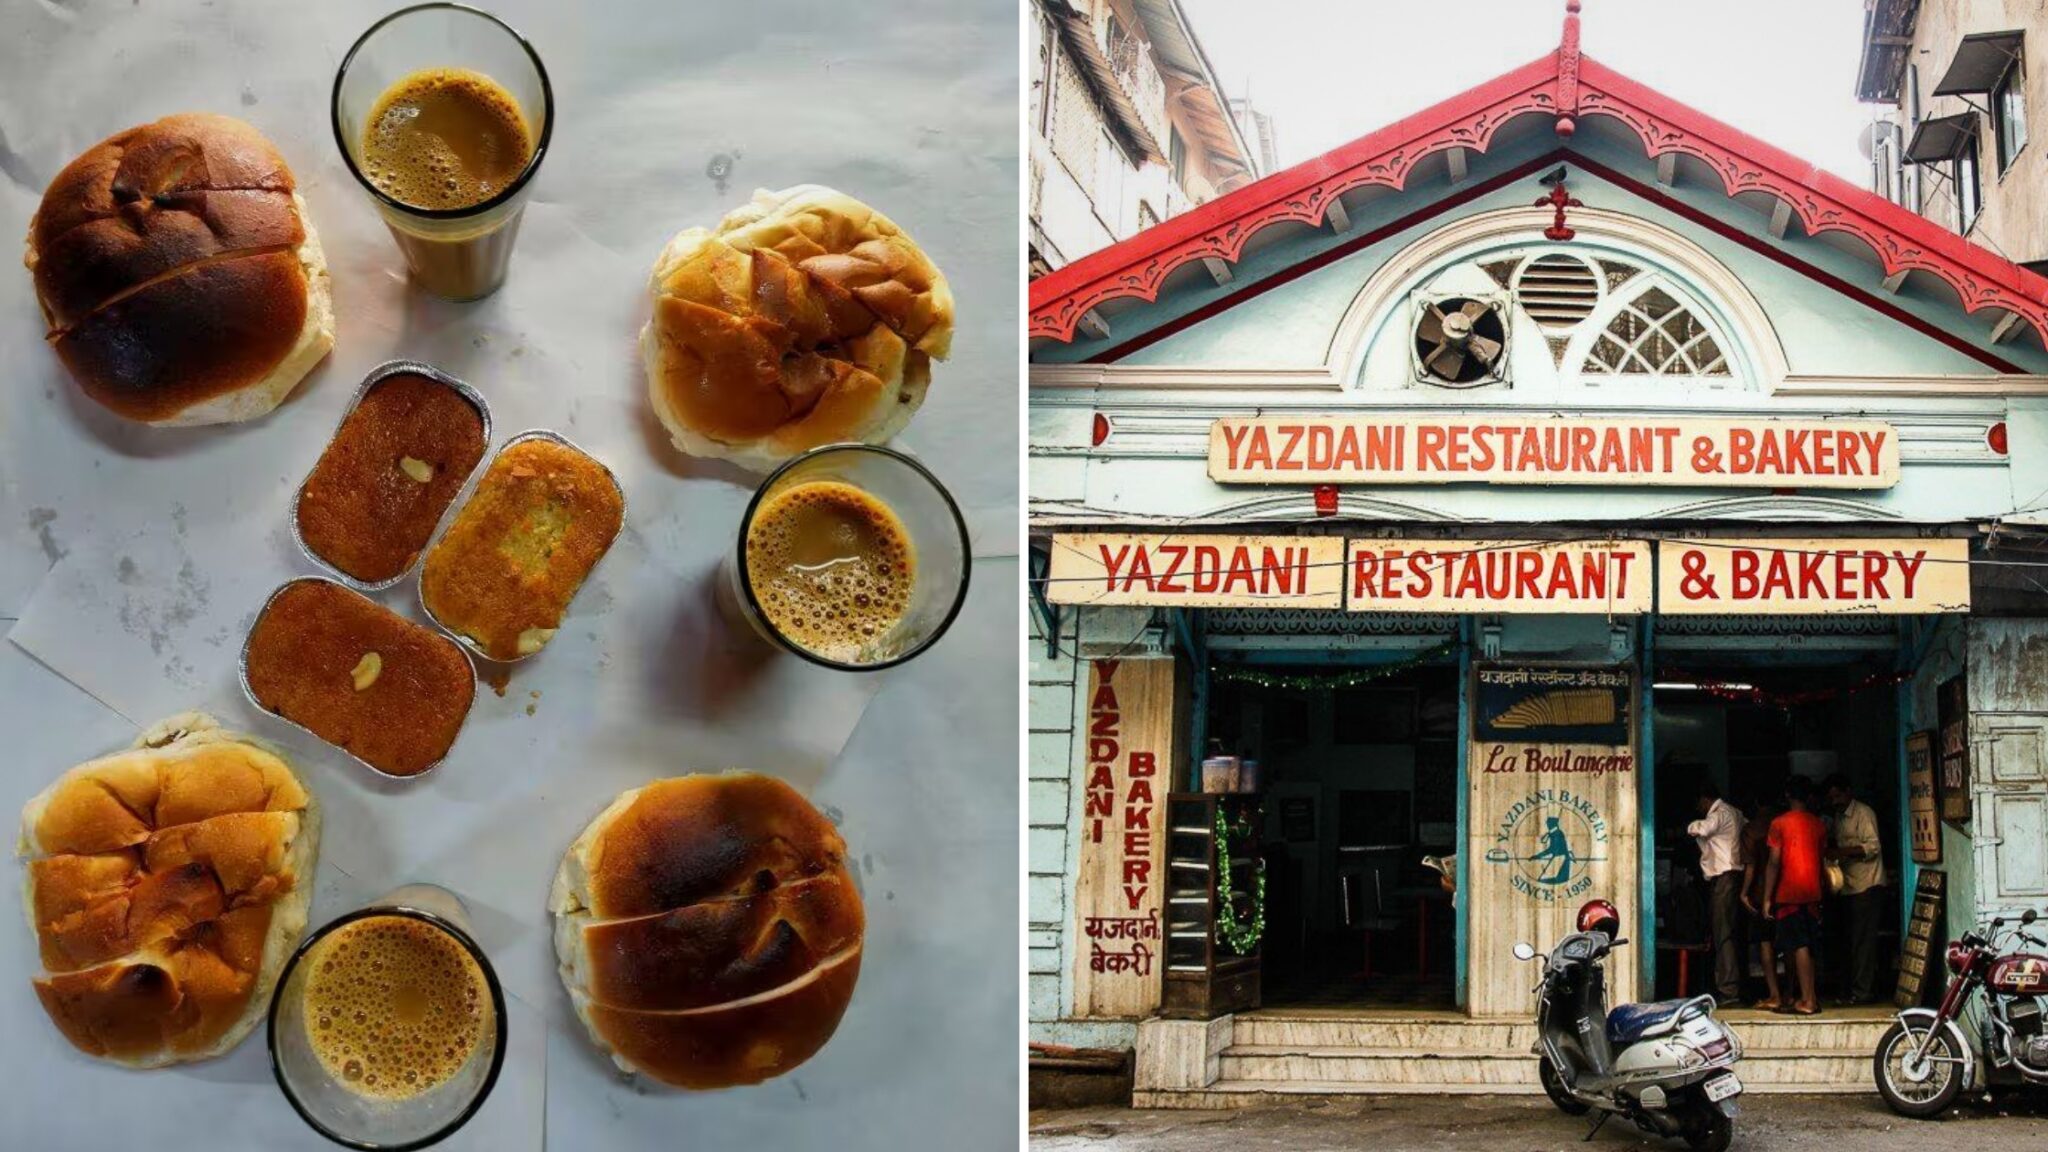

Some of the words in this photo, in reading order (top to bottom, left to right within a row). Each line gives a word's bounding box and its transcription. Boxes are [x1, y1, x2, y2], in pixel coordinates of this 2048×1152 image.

[1222, 425, 1404, 472] YAZDANI
[1416, 425, 1681, 473] RESTAURANT
[1690, 436, 1726, 475] &
[1729, 428, 1887, 476] BAKERY
[1099, 544, 1309, 595] YAZDANI
[1354, 549, 1637, 600] RESTAURANT
[1680, 550, 1720, 600] &
[1732, 549, 1928, 600] BAKERY
[1085, 659, 1121, 844] YAZDANI
[1483, 744, 1518, 773] La
[1122, 751, 1156, 911] BAKERY
[1497, 789, 1554, 844] YAZDANI
[1559, 789, 1609, 845] BAKERY
[1510, 874, 1555, 902] SINCE
[1566, 875, 1593, 899] 1950
[1089, 942, 1155, 977] बेकरी
